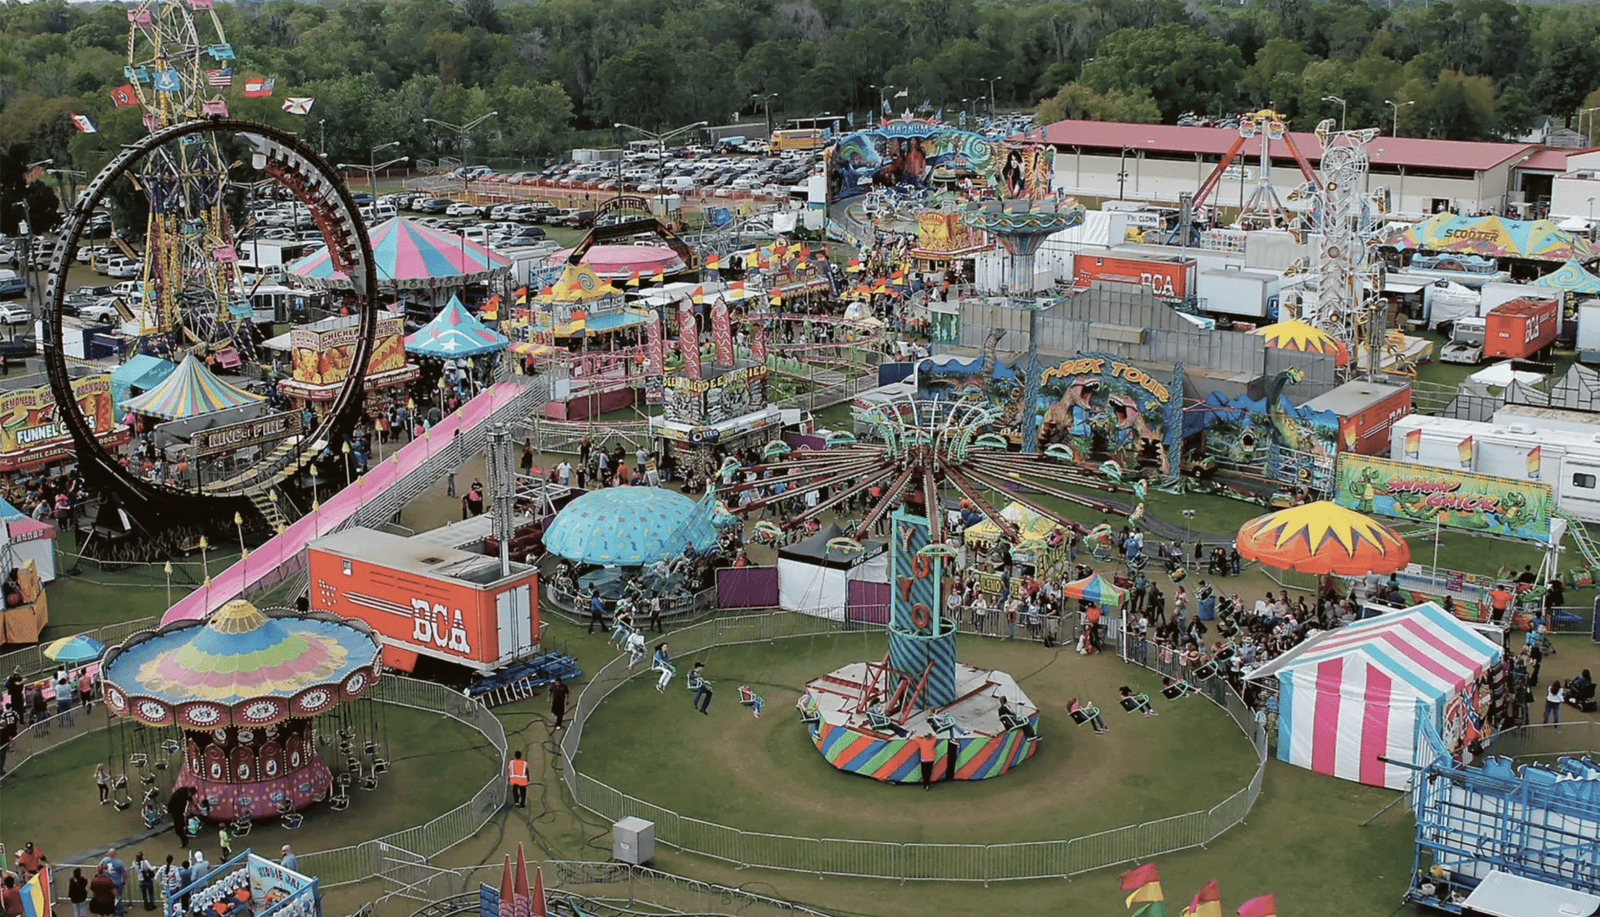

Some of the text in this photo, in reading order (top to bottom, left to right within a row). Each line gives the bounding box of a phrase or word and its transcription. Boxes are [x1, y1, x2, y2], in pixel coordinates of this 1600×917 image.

[886, 124, 929, 134] MAGNUM
[1444, 228, 1499, 242] SCOOTER
[1524, 314, 1540, 344] BCA
[701, 364, 768, 393] DEEP FRIED
[1041, 358, 1171, 403] T-REX TOUR
[16, 424, 59, 445] FUNNEL
[253, 419, 286, 438] FIRE
[1426, 493, 1500, 513] GATOR
[982, 577, 1020, 599] LEMODE
[411, 597, 471, 654] BCA
